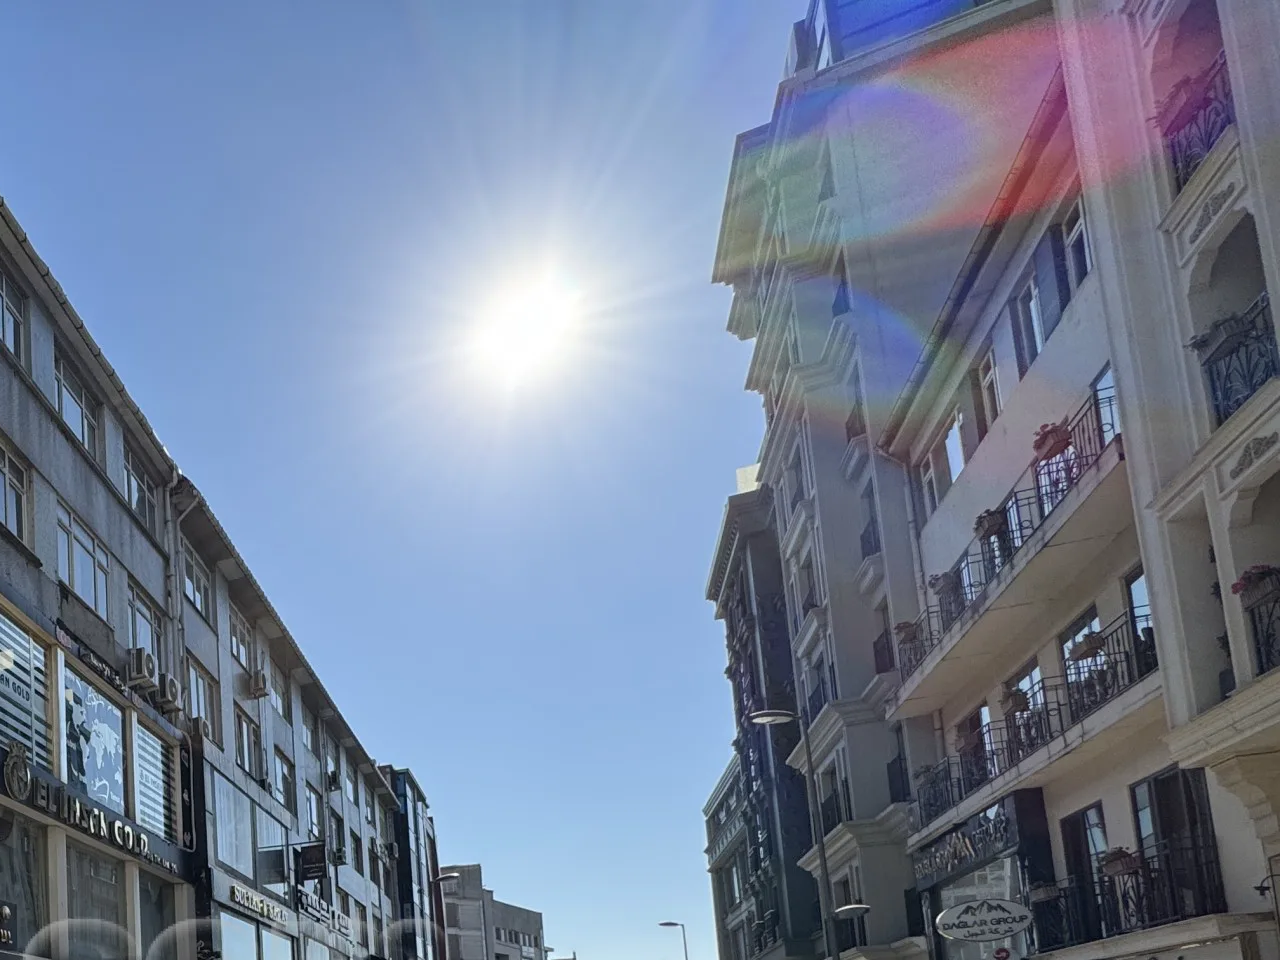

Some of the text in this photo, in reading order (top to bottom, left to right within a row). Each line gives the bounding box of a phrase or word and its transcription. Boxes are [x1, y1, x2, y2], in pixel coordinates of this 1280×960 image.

[12, 681, 30, 702] GOLD
[33, 776, 58, 813] EL
[990, 914, 1028, 927] GROUP
